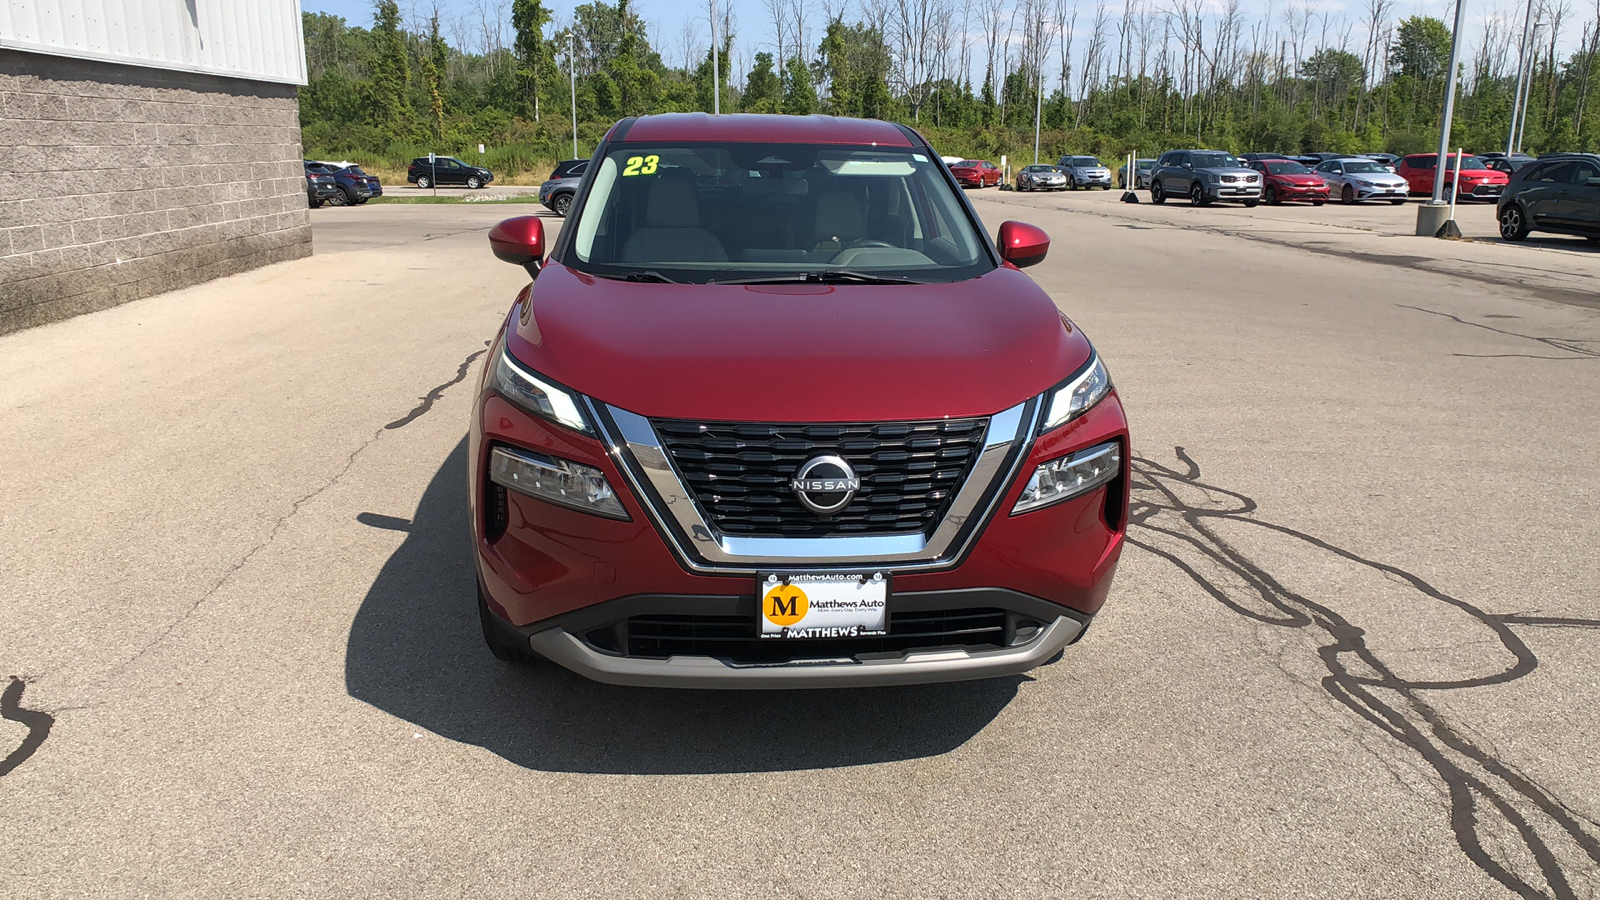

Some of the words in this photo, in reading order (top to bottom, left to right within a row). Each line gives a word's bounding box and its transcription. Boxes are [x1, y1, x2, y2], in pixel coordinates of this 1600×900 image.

[622, 155, 659, 176] 23
[794, 480, 858, 490] NISSAN
[769, 596, 799, 616] M
[809, 599, 858, 608] Matthews
[859, 599, 884, 608] Auto
[787, 626, 858, 639] MATTHEWS
